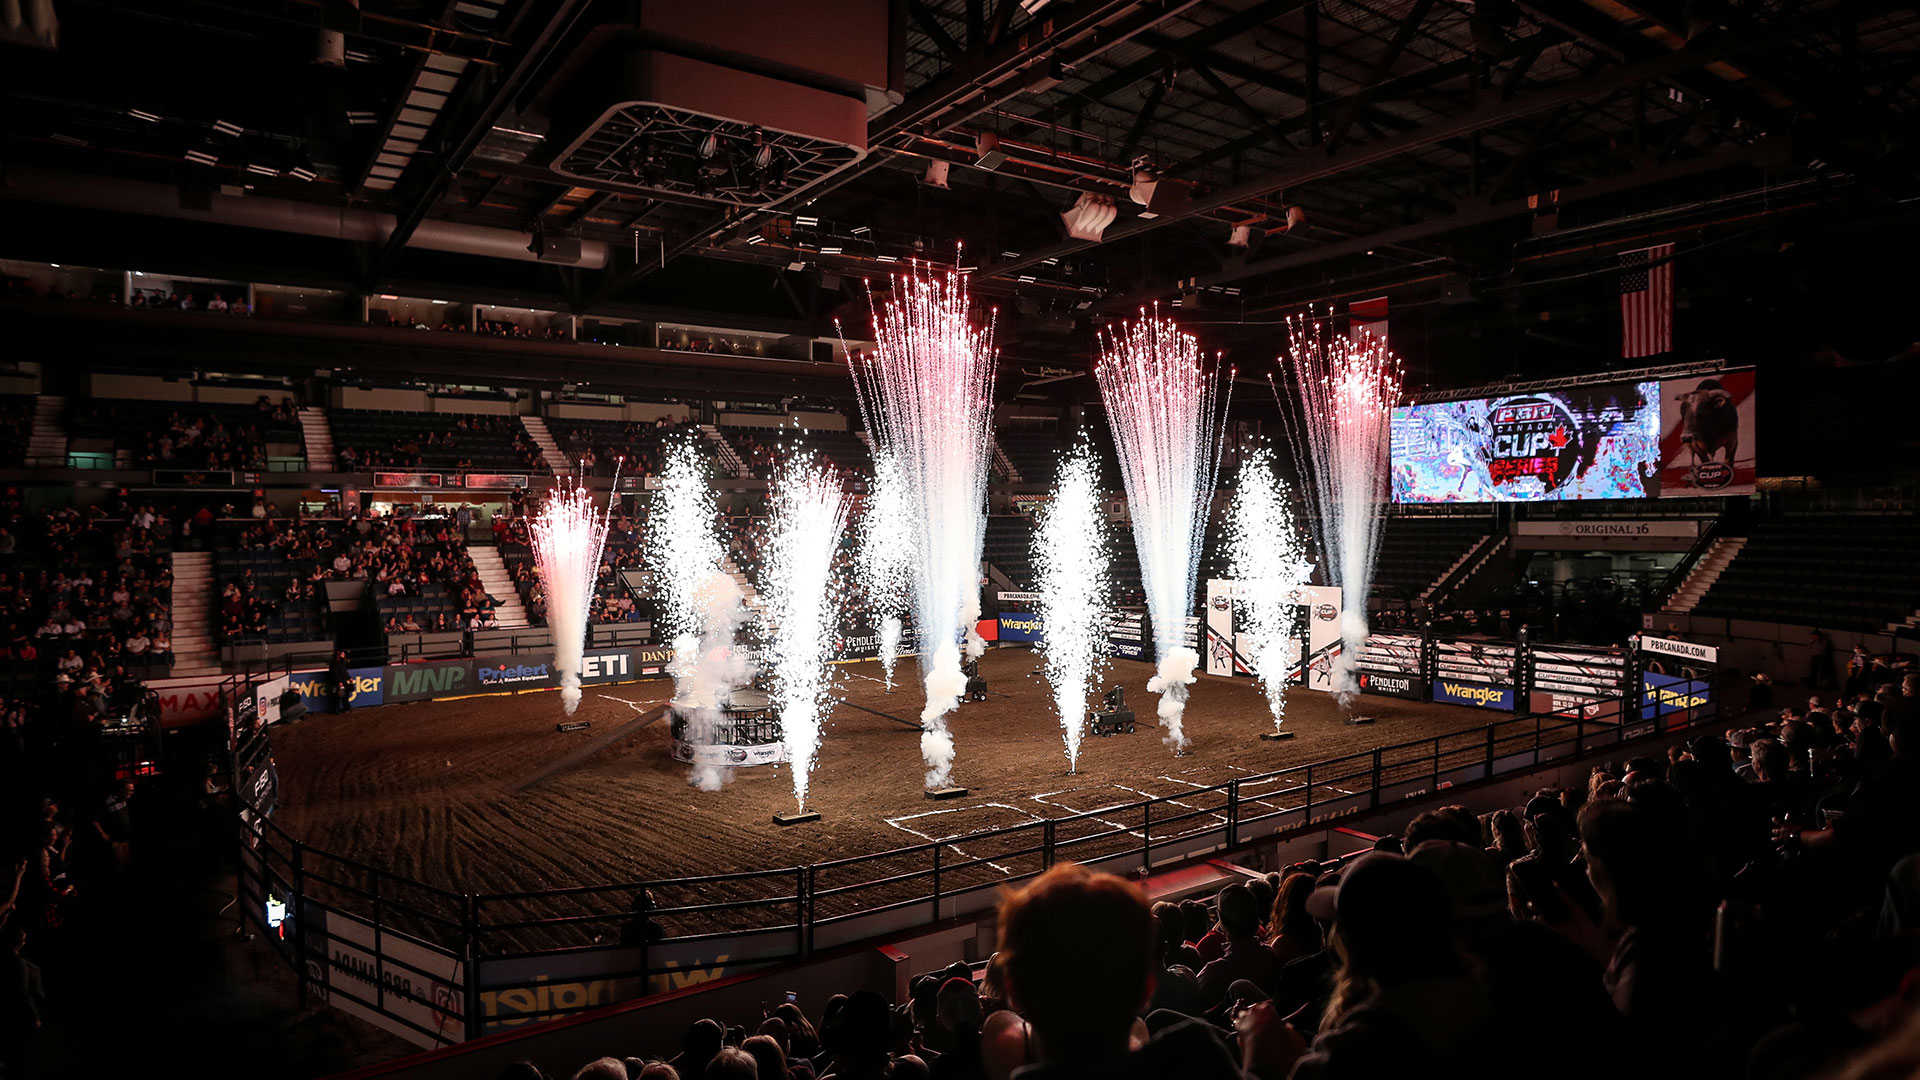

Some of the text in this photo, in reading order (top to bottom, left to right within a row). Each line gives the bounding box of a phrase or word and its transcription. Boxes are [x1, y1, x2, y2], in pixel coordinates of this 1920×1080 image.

[1497, 423, 1553, 433] CANADA
[1494, 433, 1550, 458] CUP
[1699, 470, 1721, 479] CUP
[1576, 523, 1649, 534] ORIGINAL 16
[1000, 618, 1043, 634] Wrangler
[846, 636, 882, 648] PENDLET
[1118, 644, 1142, 652] COOPER
[1651, 640, 1706, 657] PBRCANADA.COM
[642, 651, 665, 662] DAN
[478, 664, 548, 680] Priefert
[582, 654, 627, 677] ETI
[392, 666, 464, 696] MNP
[1370, 675, 1409, 691] PENDLETON
[1443, 682, 1504, 706] Wrangler
